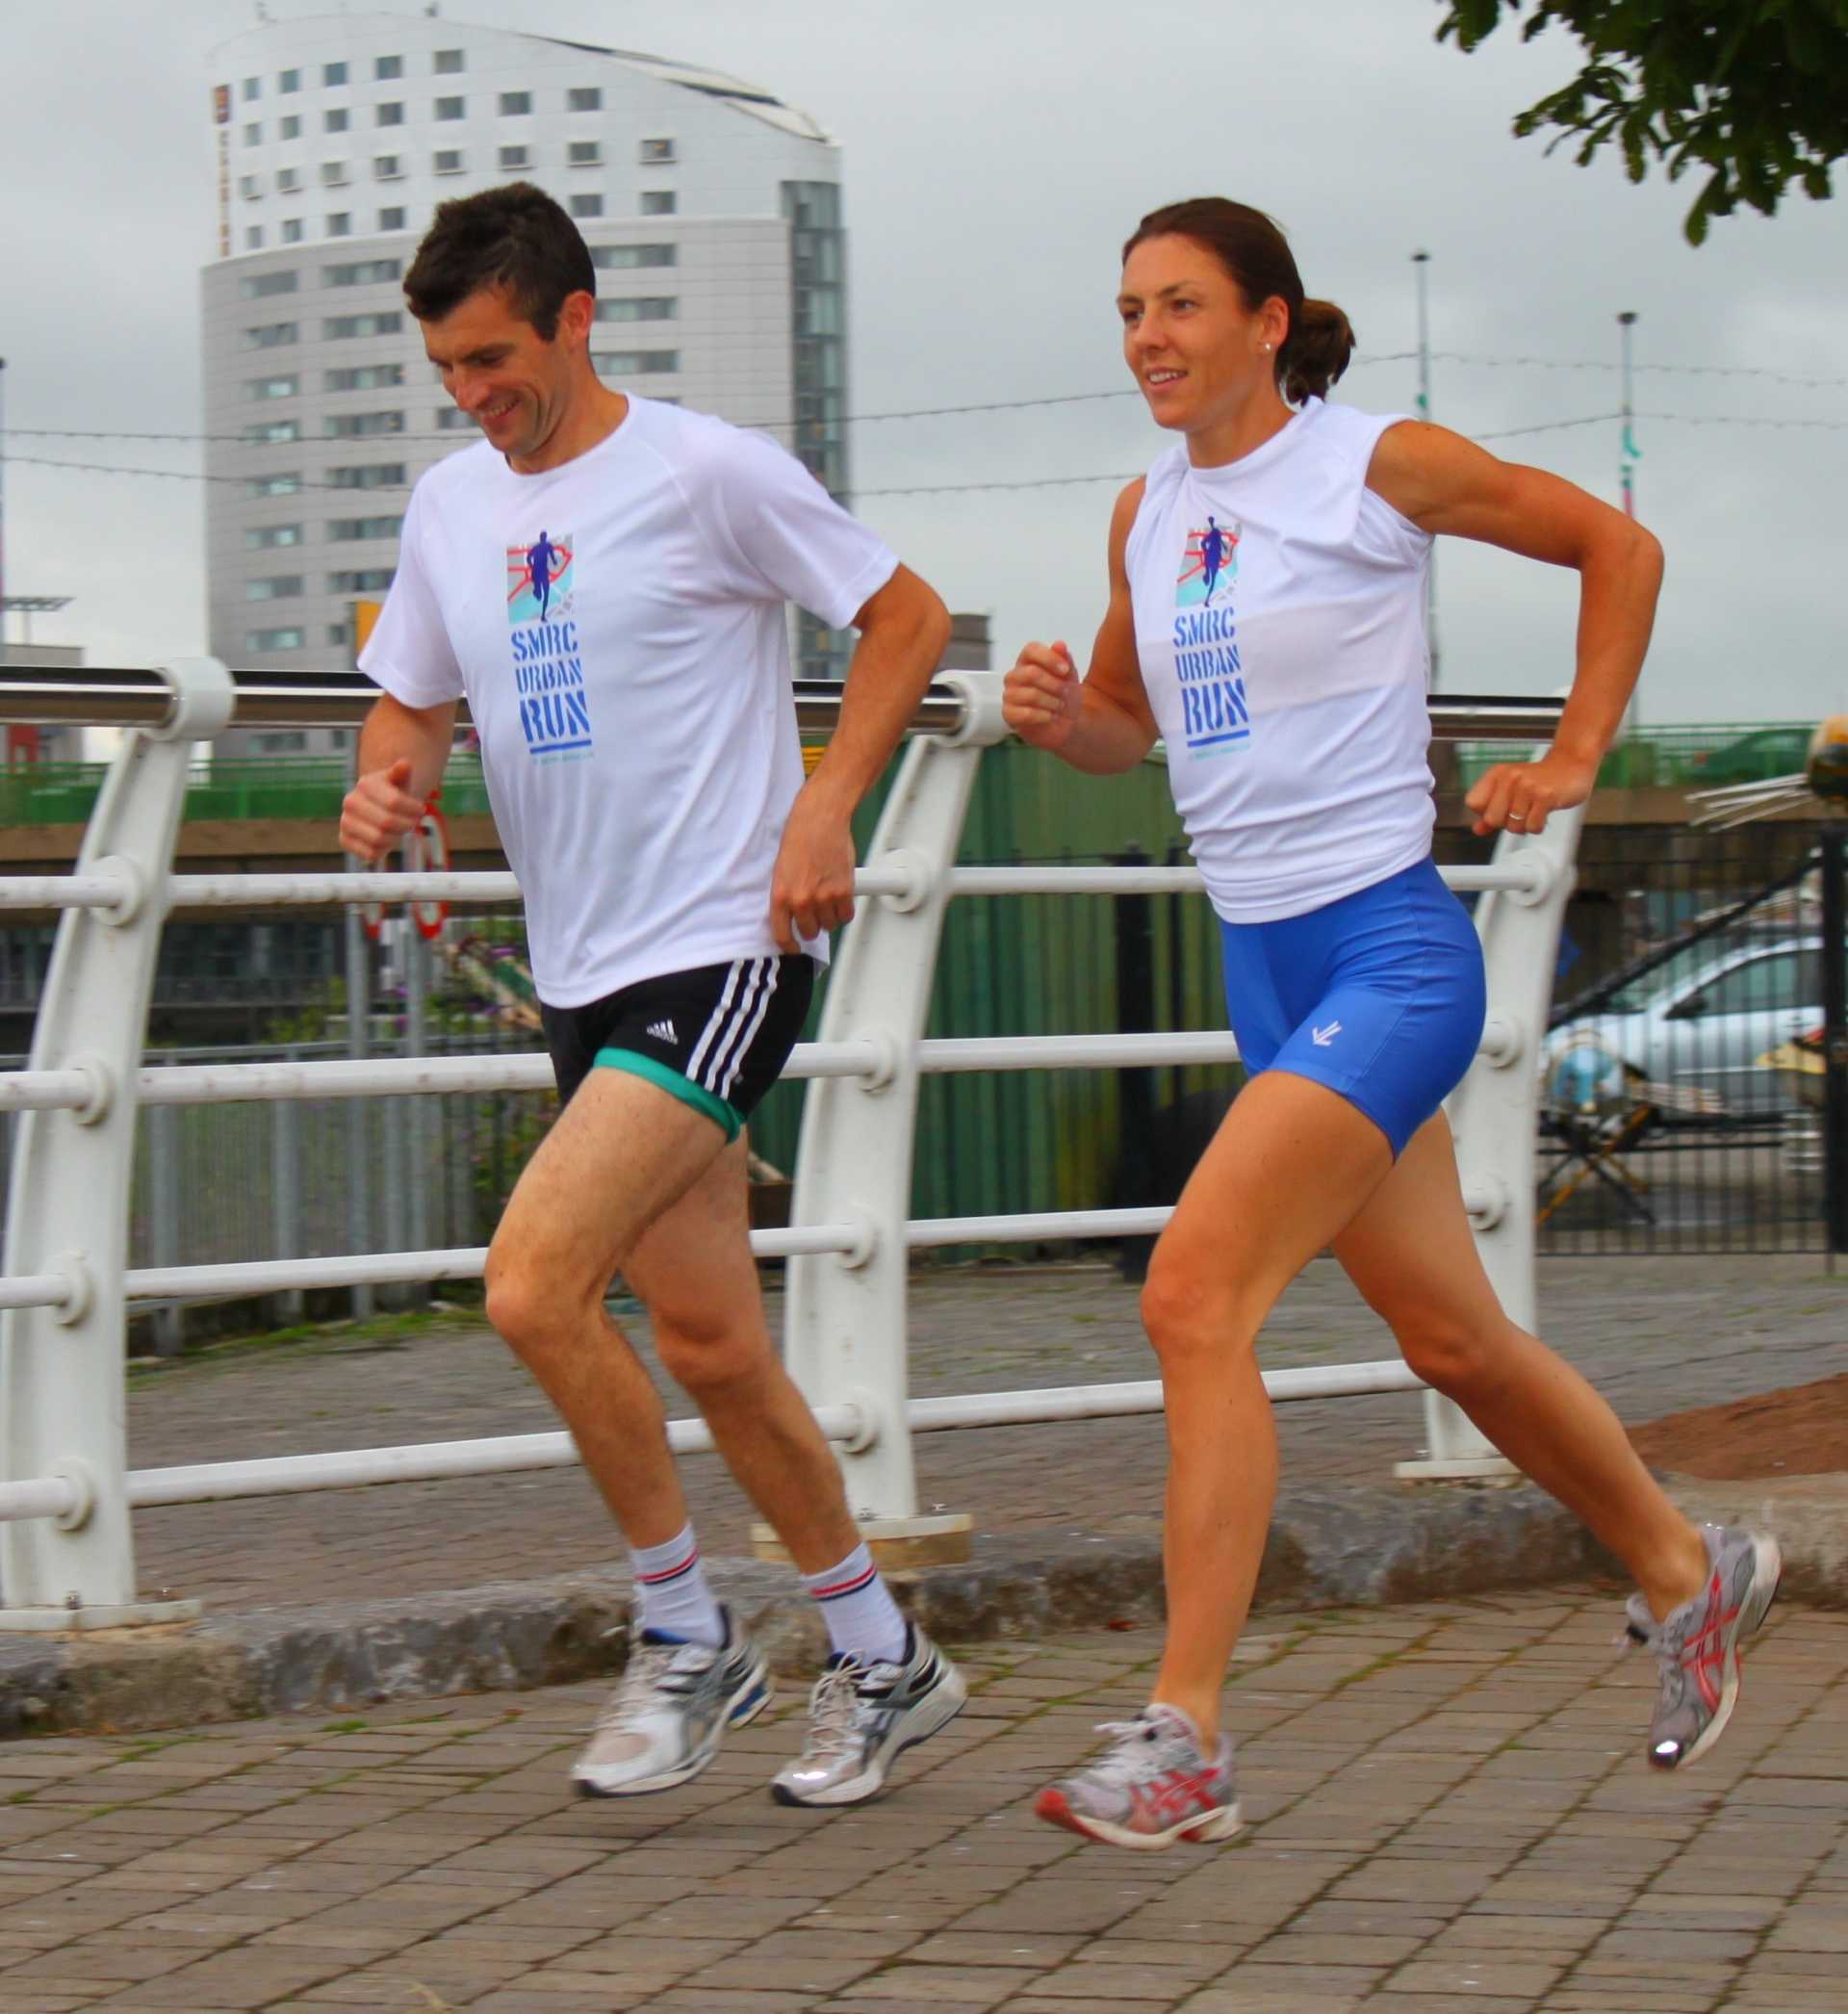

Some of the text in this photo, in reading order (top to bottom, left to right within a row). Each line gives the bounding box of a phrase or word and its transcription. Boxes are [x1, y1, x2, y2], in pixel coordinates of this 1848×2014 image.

[510, 621, 578, 662] SMRC
[1173, 607, 1236, 648] SMRC
[515, 658, 583, 694] URBAN
[1174, 644, 1242, 683] URBAN
[520, 689, 591, 743] RUN
[1181, 678, 1248, 735] RUN
